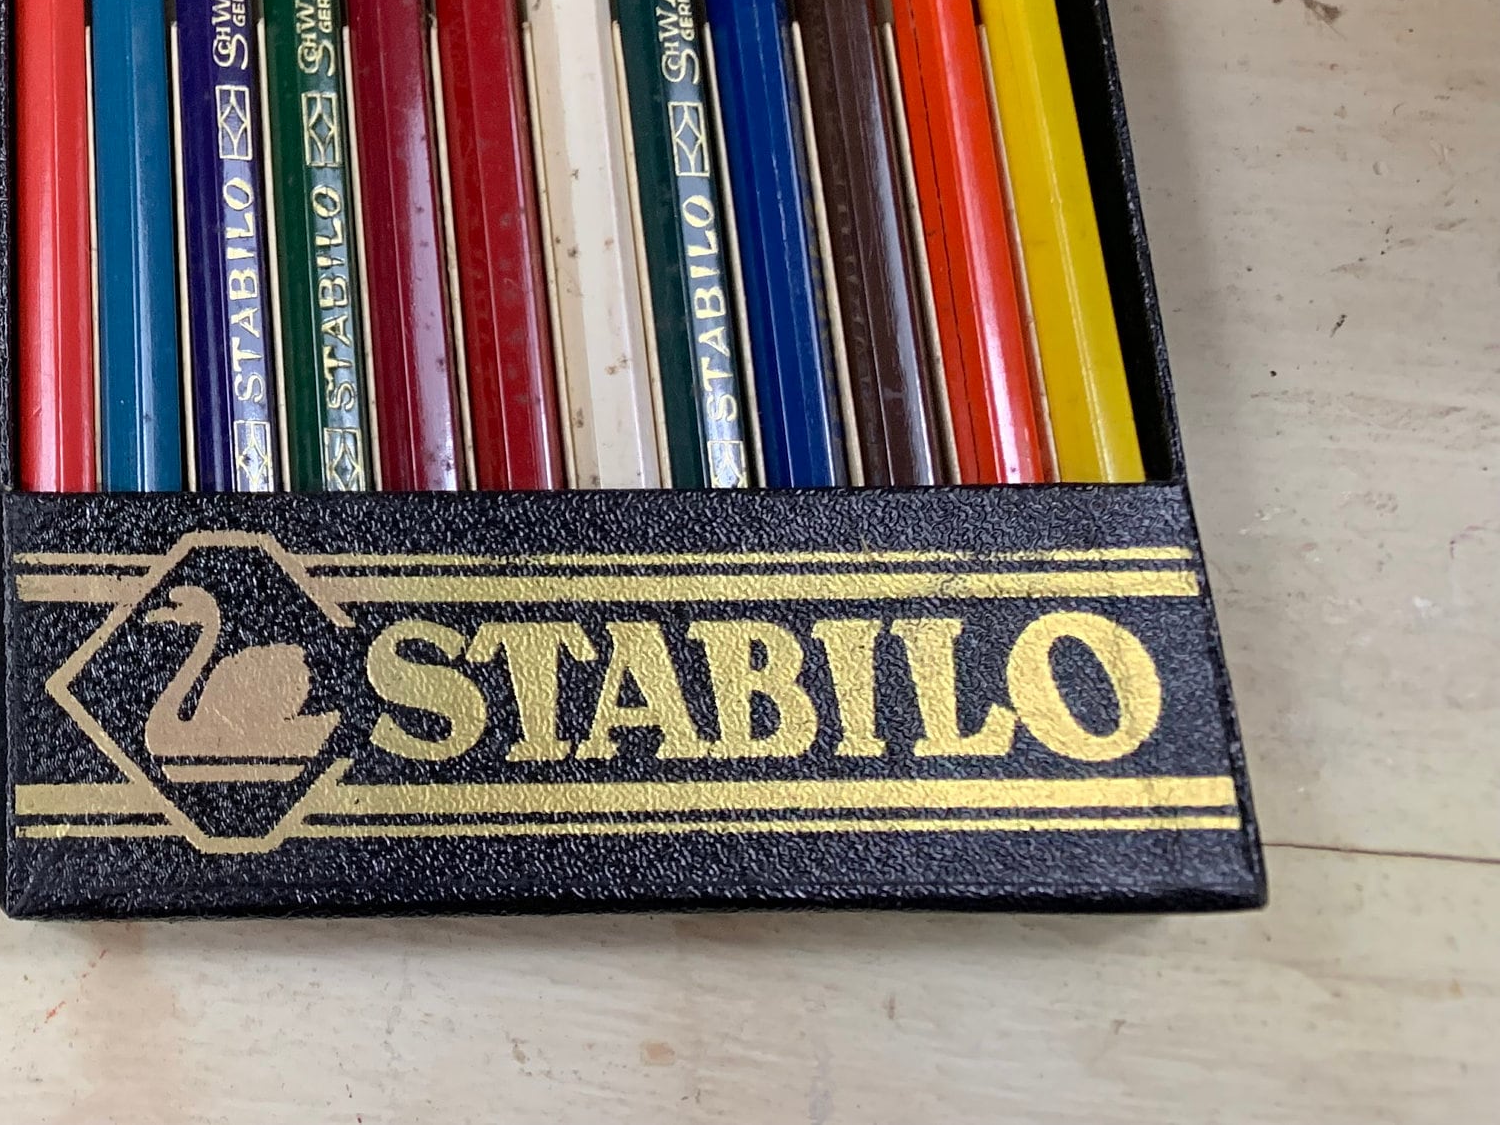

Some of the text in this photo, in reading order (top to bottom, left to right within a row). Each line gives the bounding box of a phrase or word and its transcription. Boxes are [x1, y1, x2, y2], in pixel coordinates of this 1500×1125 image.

[222, 176, 264, 403] STABILO
[310, 185, 355, 411] STABILO
[682, 195, 738, 422] STABILO
[366, 611, 1163, 762] STABILO
